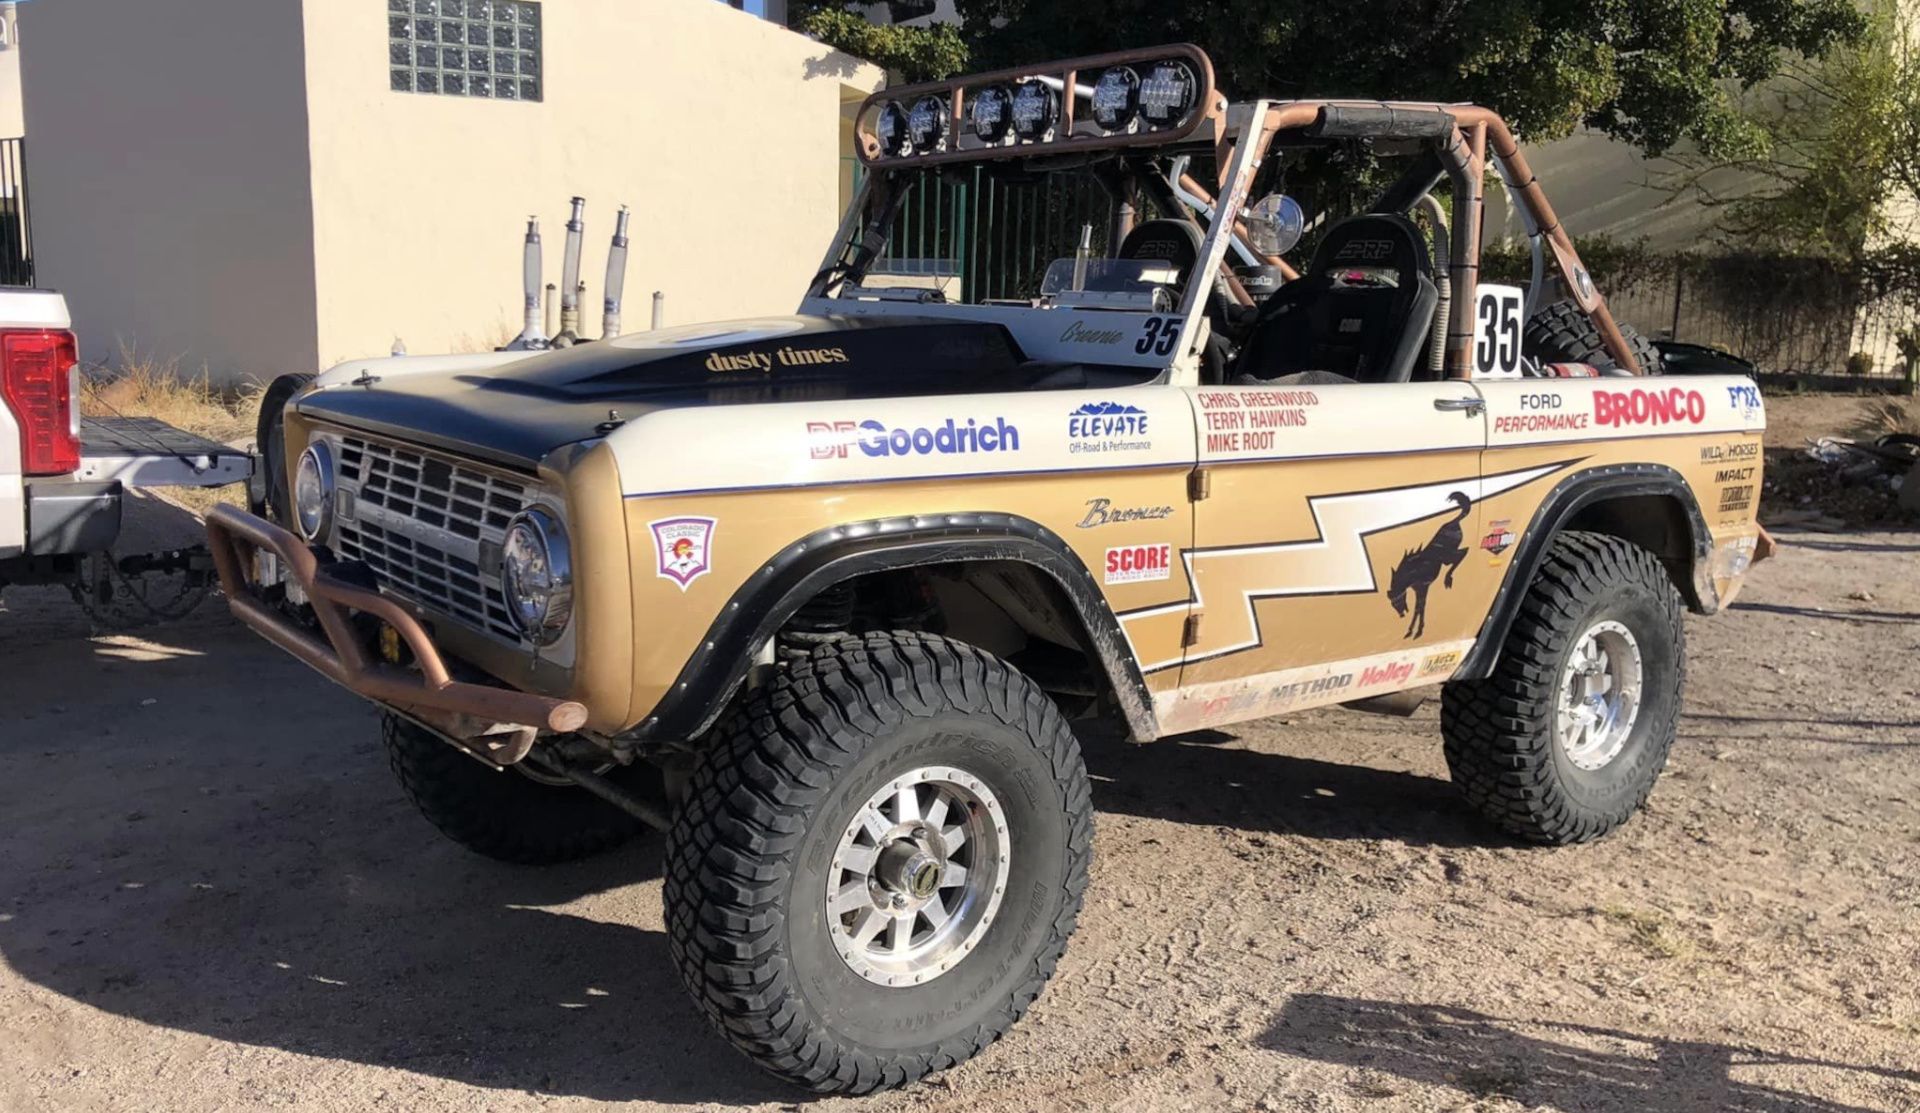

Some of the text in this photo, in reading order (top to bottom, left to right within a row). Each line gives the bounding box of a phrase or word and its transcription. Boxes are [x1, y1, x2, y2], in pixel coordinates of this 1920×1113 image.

[1334, 239, 1395, 259] PRP
[1134, 316, 1183, 357] 35
[1477, 293, 1519, 374] 35
[705, 352, 771, 372] dusty
[1197, 391, 1319, 410] CHRIS GREENWOOD
[1520, 394, 1562, 410] FORD
[1592, 387, 1705, 427] BRONCO
[1727, 386, 1760, 408] FOX
[1069, 415, 1148, 438] ELEVATE
[1204, 408, 1307, 431] TERRY HAWKINS
[1494, 412, 1589, 433] PERFORMANCE
[806, 416, 1019, 460] BFGoodrich
[1069, 439, 1151, 454] Off-Road & Performance
[1207, 431, 1275, 453] MIKE ROOT
[1701, 443, 1758, 460] WILD HORSES
[1715, 467, 1755, 483] IMPACT
[1074, 498, 1175, 529] Bronco
[1106, 545, 1169, 573] SCORE
[1270, 673, 1352, 699] METHOD
[1357, 662, 1415, 688] Holley
